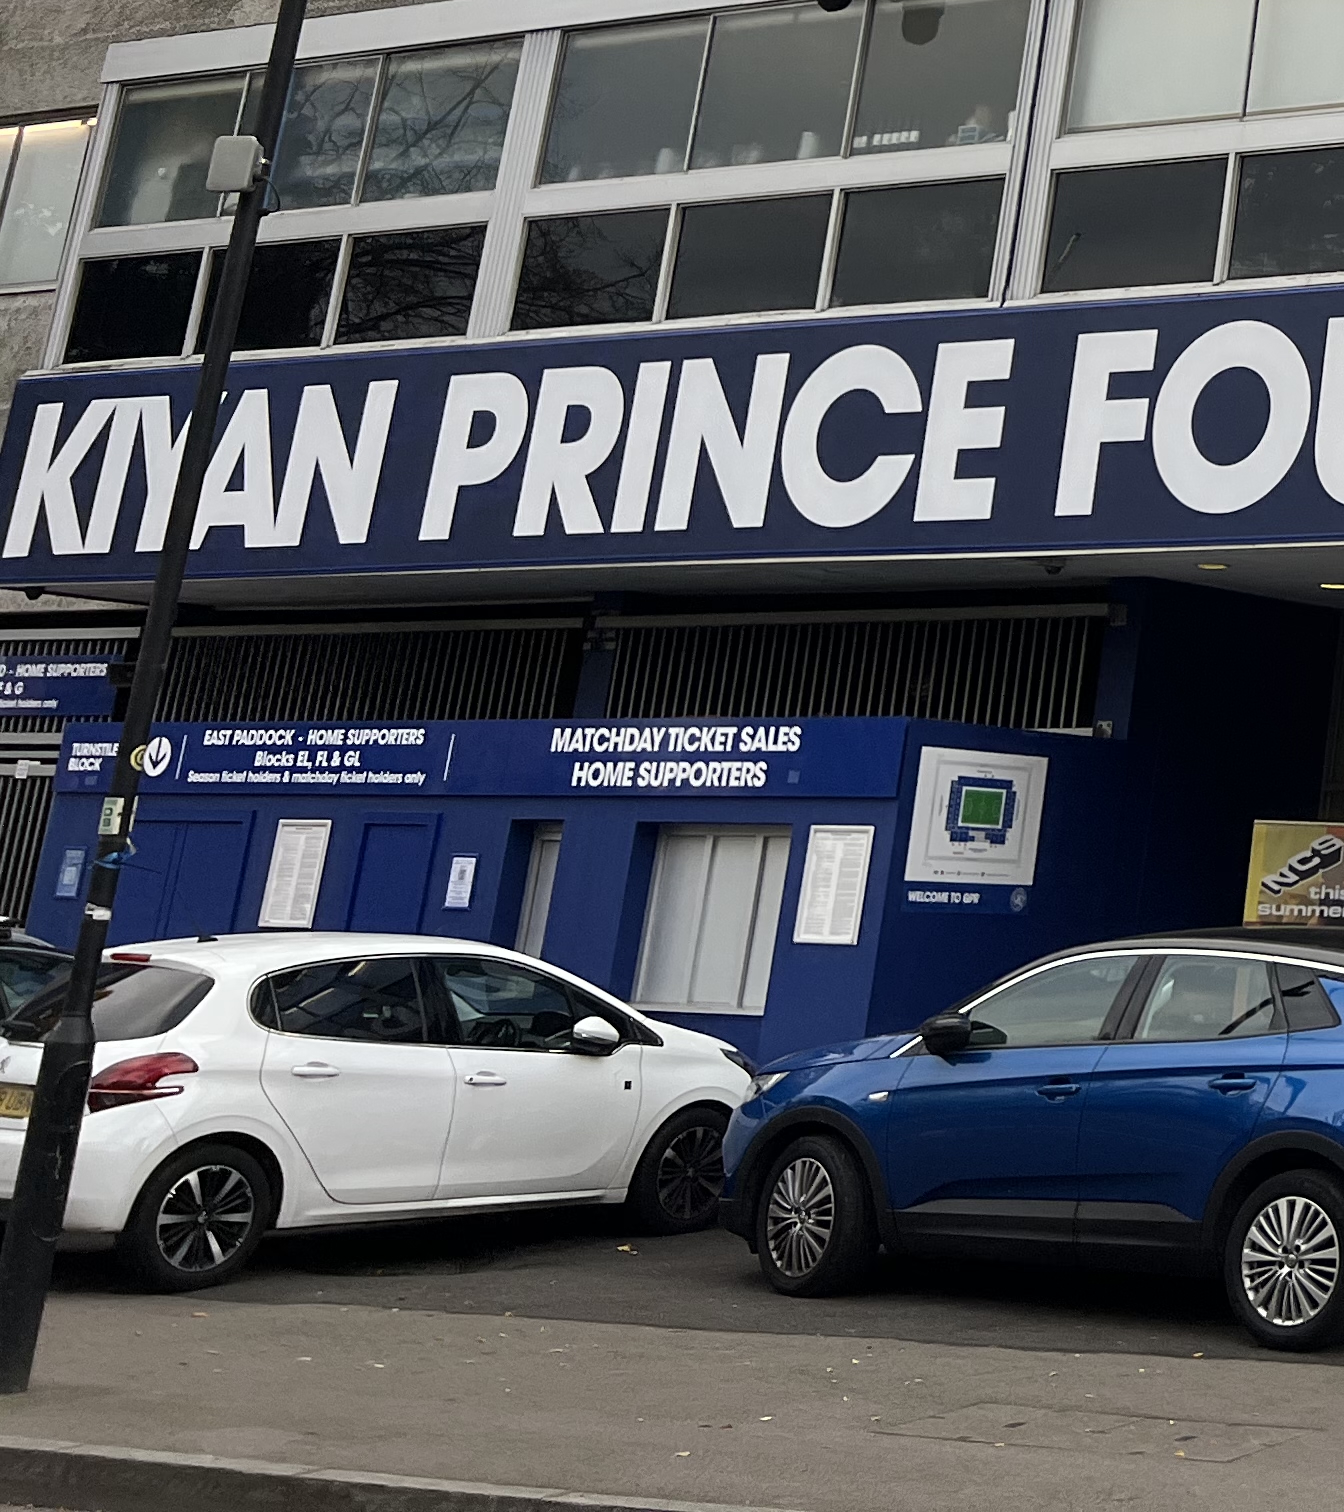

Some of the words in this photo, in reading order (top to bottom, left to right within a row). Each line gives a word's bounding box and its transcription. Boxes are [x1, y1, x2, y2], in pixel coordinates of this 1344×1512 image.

[2, 379, 398, 558] KIYAN
[418, 338, 1015, 541] PRINCE
[47, 663, 108, 677] SUPPORTERS
[203, 729, 233, 745] EAST
[232, 729, 296, 745] PADDOCK
[306, 729, 346, 745] HOME
[346, 728, 426, 745] SUPPORTERS
[550, 727, 667, 753] MATCHDAY
[667, 727, 738, 752] TICKET
[739, 726, 802, 752] SALES
[72, 743, 119, 756] TURNSTILE
[68, 757, 102, 771] BLOCK
[254, 751, 295, 767] Blocks
[315, 751, 328, 767] FL
[330, 751, 342, 767] &
[344, 751, 361, 767] GL
[187, 770, 220, 782] Season
[247, 770, 281, 783] holders
[282, 771, 290, 782] &
[291, 770, 340, 785] matchday
[367, 770, 403, 784] holders
[404, 771, 427, 786] only
[571, 762, 636, 787] HOME
[637, 761, 768, 787] SUPPORTERS
[1261, 834, 1344, 896] NCS
[908, 890, 949, 903] WELCOME
[950, 891, 961, 903] TO
